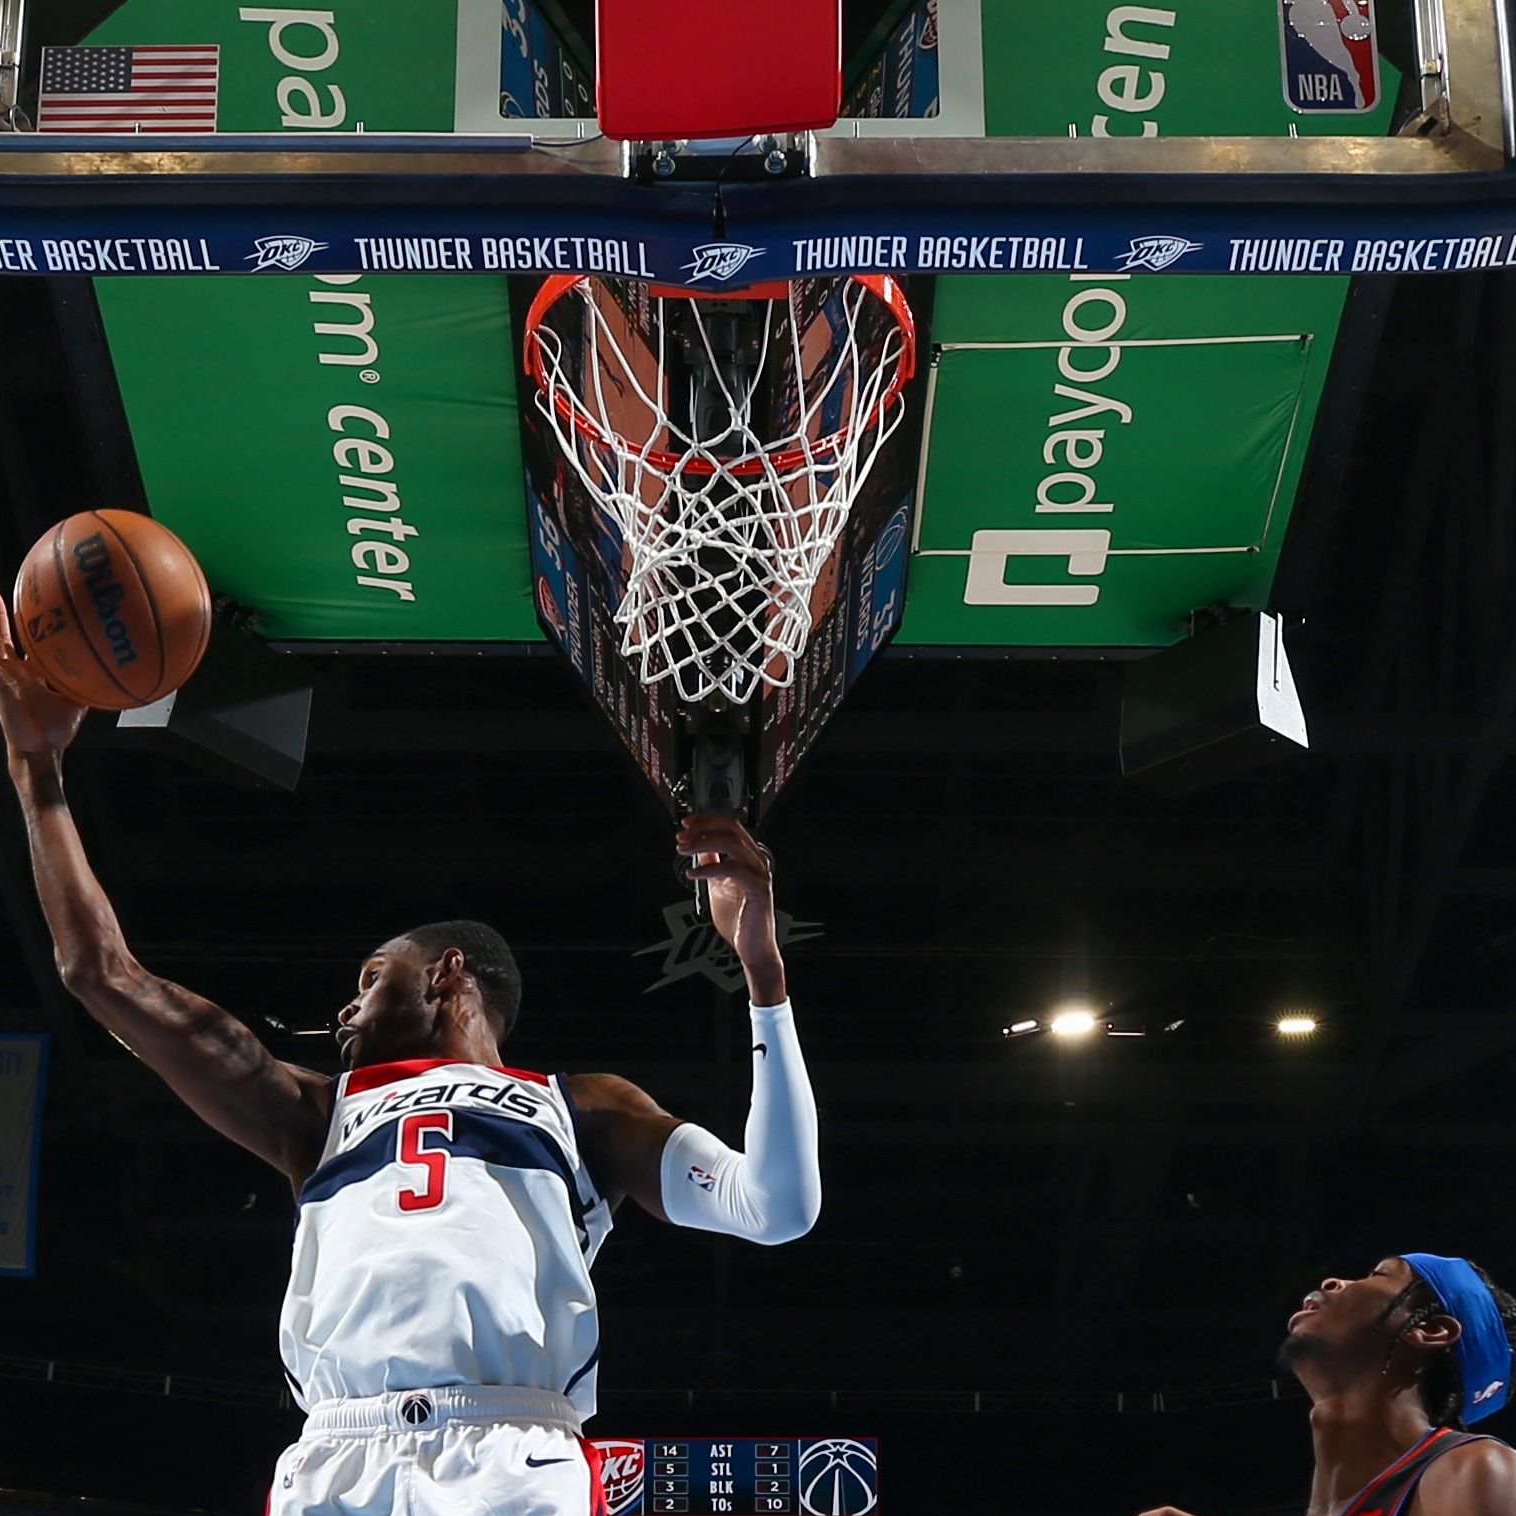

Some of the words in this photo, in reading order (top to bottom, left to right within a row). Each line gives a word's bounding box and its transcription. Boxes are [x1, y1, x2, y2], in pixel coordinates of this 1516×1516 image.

[1298, 74, 1343, 102] NBA
[41, 238, 221, 271] BASKETBALL
[354, 237, 473, 270] THUNDER
[482, 238, 655, 278] BASKETBALL
[793, 236, 907, 271] THUNDER
[917, 237, 1088, 270] BASKETBALL
[1228, 239, 1343, 271] THUNDER
[329, 404, 419, 604] center
[73, 531, 138, 668] Wilson
[856, 542, 876, 650] WIZARDS
[565, 570, 583, 675] THUNDER
[343, 1082, 540, 1142] wizards
[396, 1108, 453, 1215] 5
[709, 1444, 733, 1458] AST
[769, 1445, 778, 1457] 7
[709, 1480, 734, 1494] BLK
[710, 1463, 732, 1476] STL
[711, 1498, 732, 1512] TOs
[766, 1499, 783, 1510] 10
